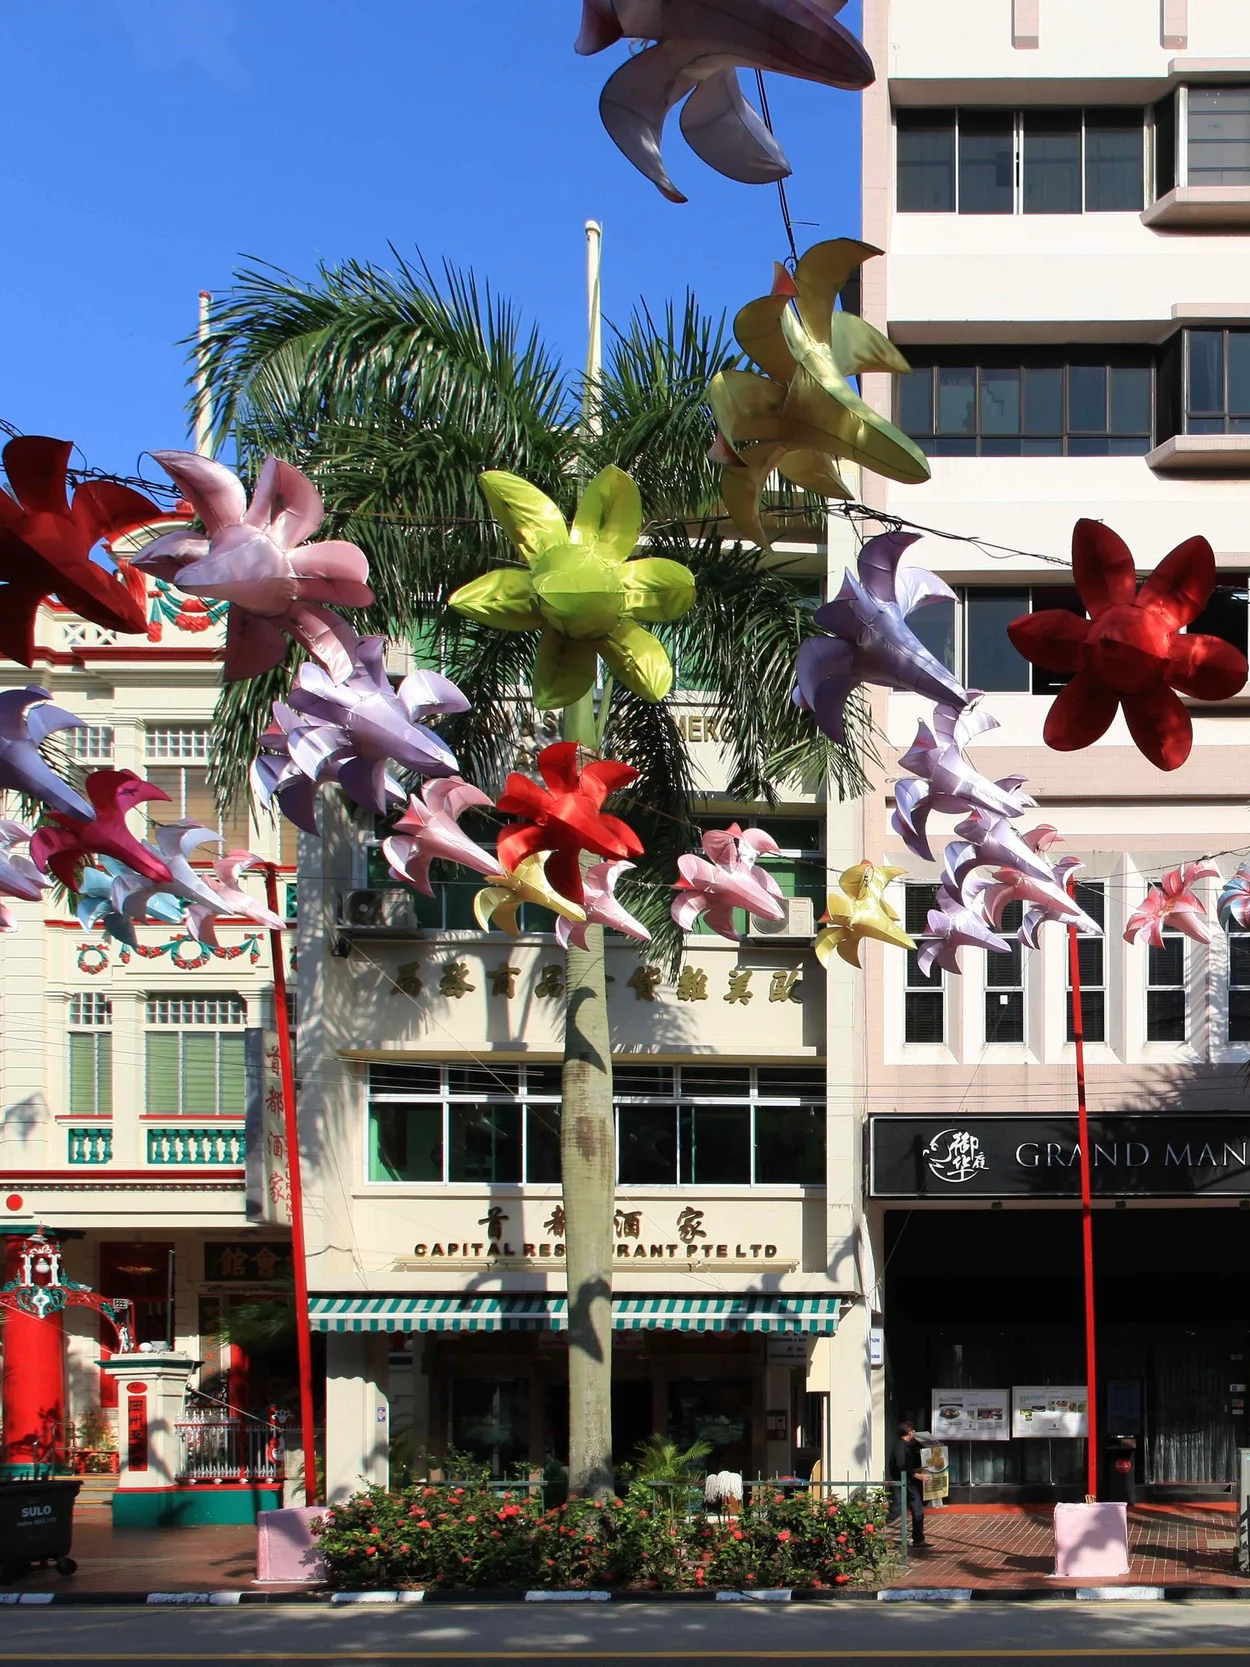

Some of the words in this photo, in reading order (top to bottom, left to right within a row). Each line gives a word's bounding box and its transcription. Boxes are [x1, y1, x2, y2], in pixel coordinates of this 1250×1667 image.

[1015, 1141, 1149, 1168] GRAND
[414, 1243, 516, 1257] CAPITAL
[524, 1243, 678, 1258] RESRANT
[686, 1244, 729, 1258] PTE
[735, 1244, 777, 1258] LTD
[22, 1505, 52, 1518] SULO
